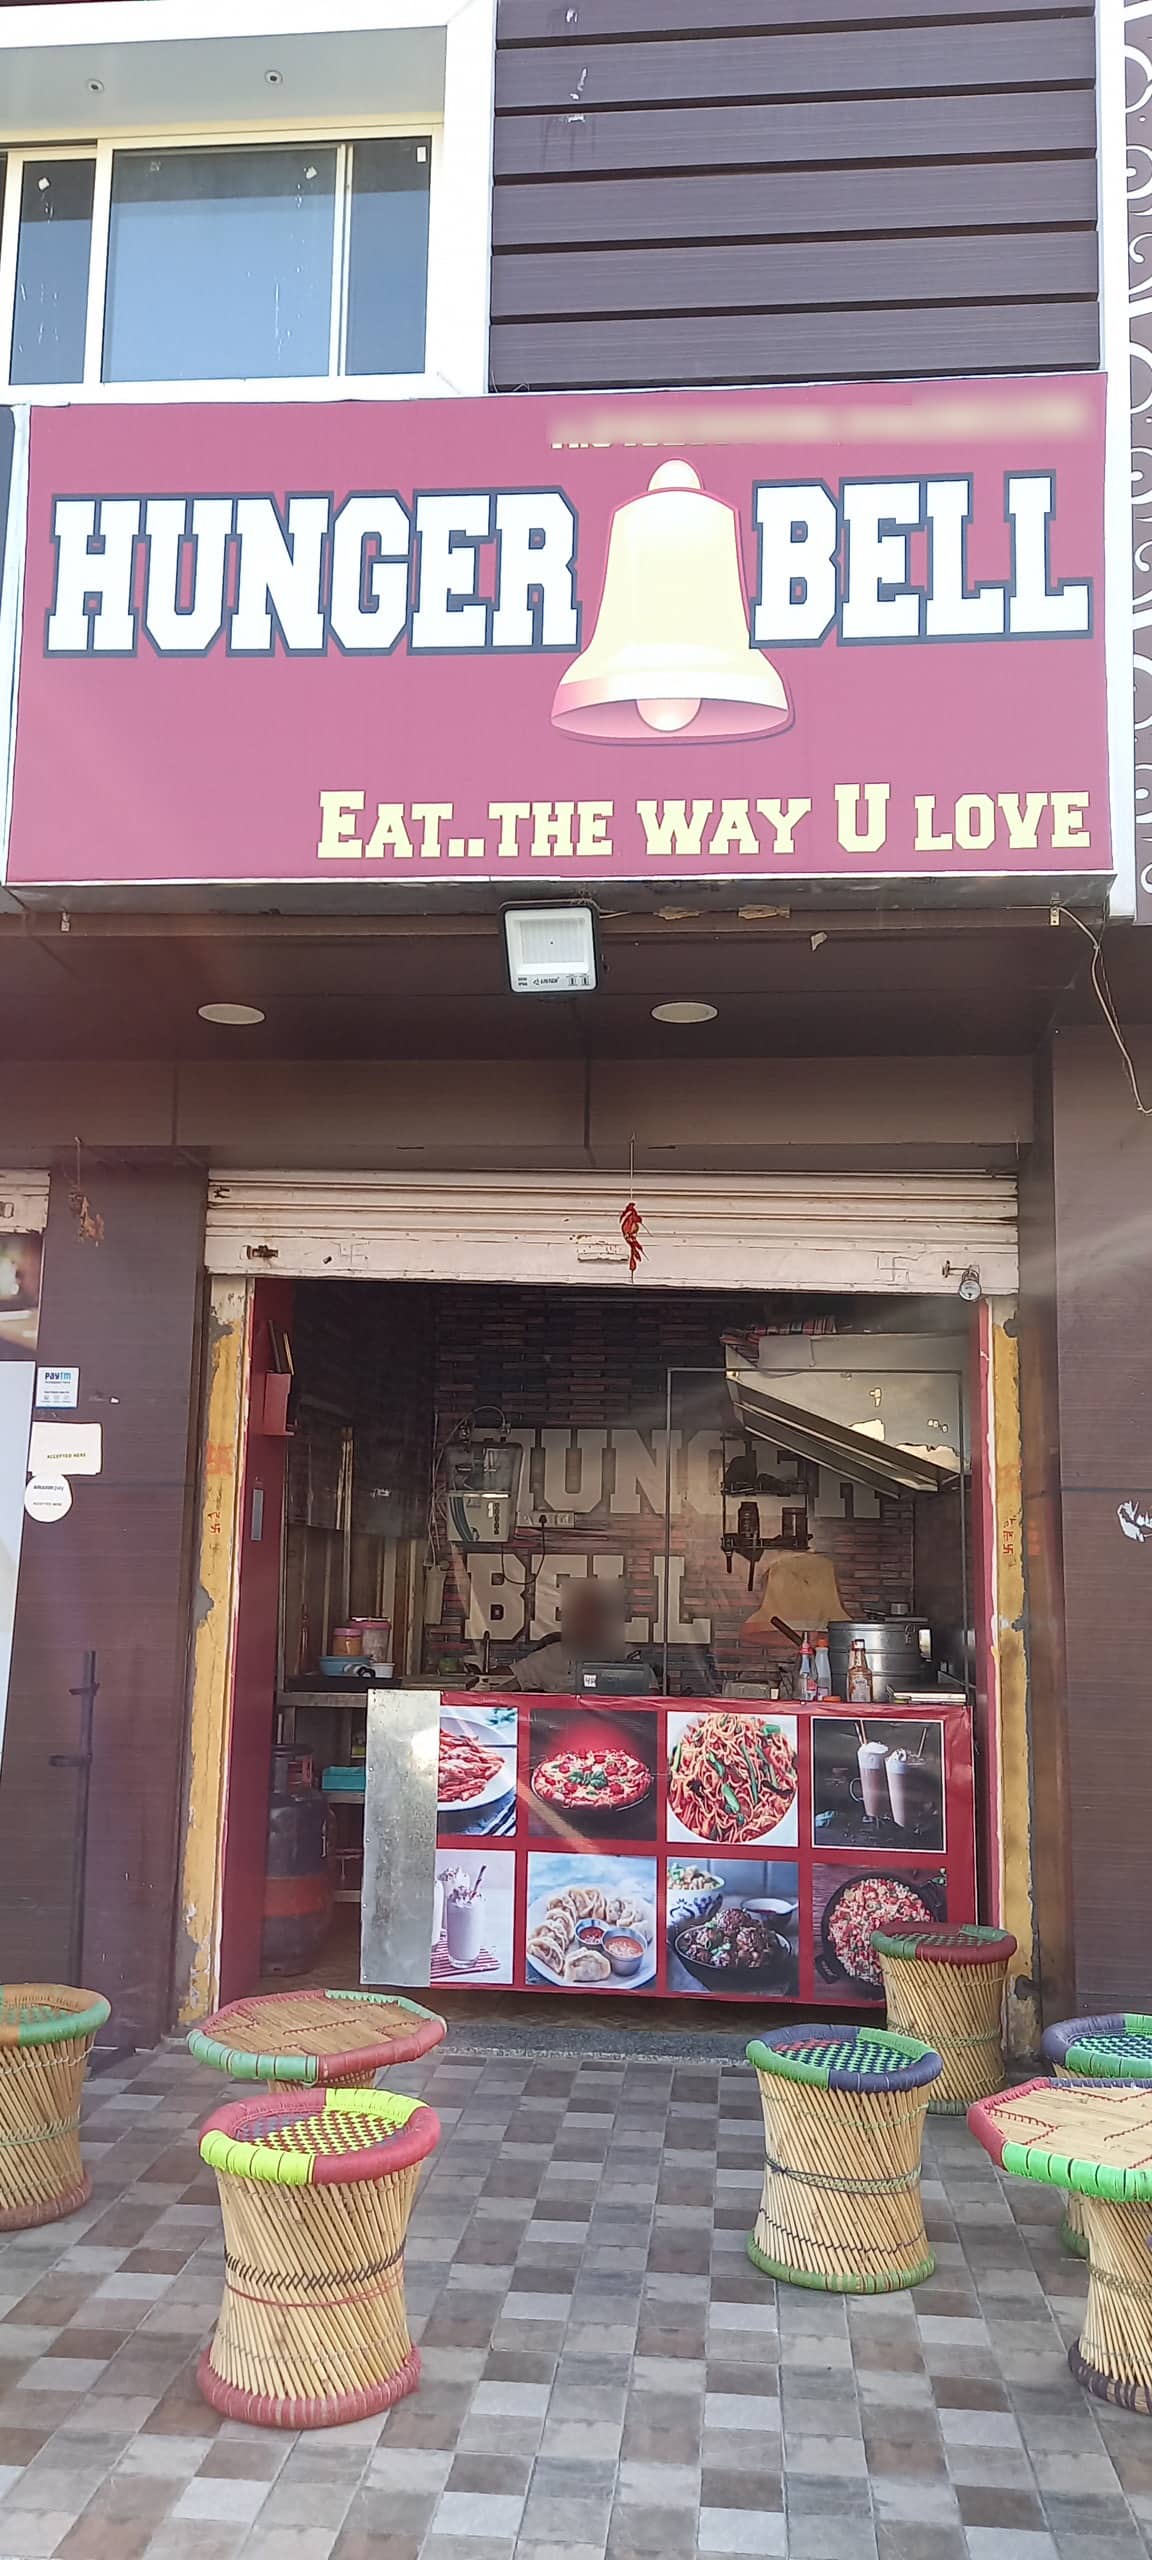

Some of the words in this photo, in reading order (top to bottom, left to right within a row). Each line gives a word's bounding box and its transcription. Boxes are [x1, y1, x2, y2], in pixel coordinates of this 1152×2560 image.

[44, 485, 582, 657] HUNGER
[749, 469, 1094, 649] BELL
[636, 798, 812, 856] WAY
[834, 783, 891, 853] U
[913, 791, 1092, 852] LOVE
